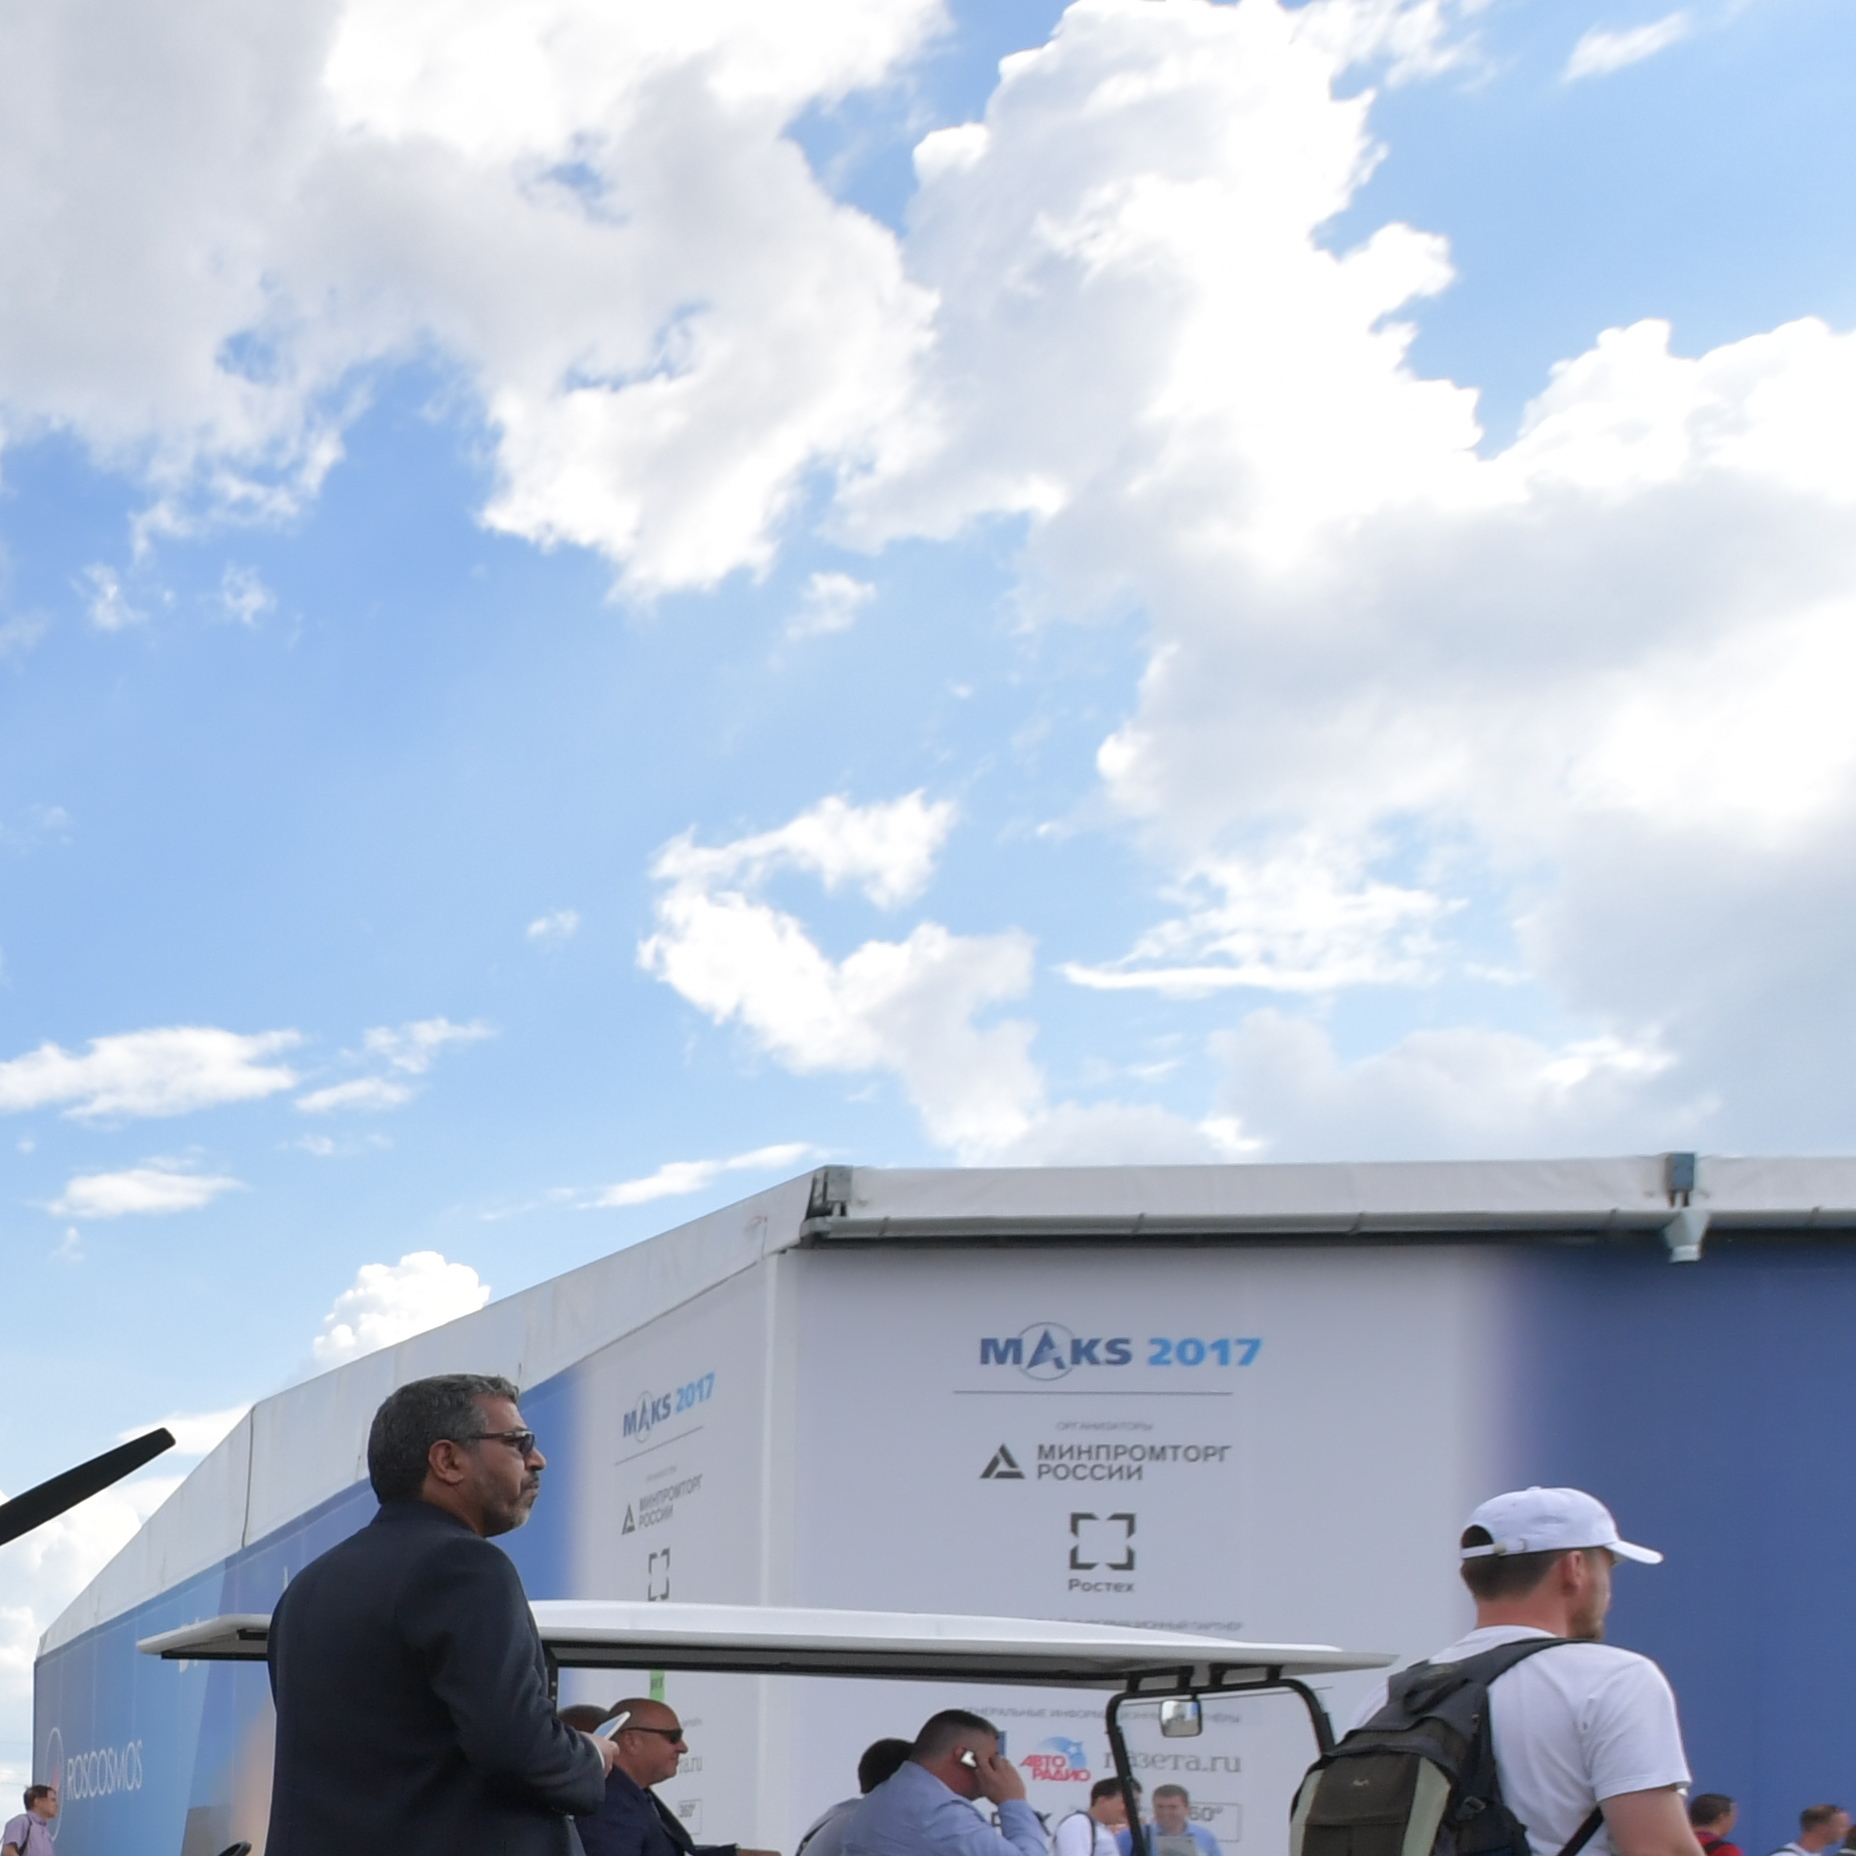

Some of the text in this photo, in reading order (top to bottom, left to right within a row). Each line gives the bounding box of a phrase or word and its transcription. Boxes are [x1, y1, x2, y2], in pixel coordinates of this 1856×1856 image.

[980, 1327, 1264, 1371] MAKS 2017
[623, 1371, 716, 1438] MAKS 2017
[1037, 1444, 1232, 1463] МИНПРОМТОРГ
[1037, 1463, 1144, 1482] РОССИИ
[639, 1504, 674, 1529] РОССИИ
[1068, 1578, 1135, 1593] Ростех
[67, 1739, 143, 1801] ROSCOSMOS
[1020, 1754, 1067, 1768] АВТО
[1031, 1767, 1091, 1782] РАДИО
